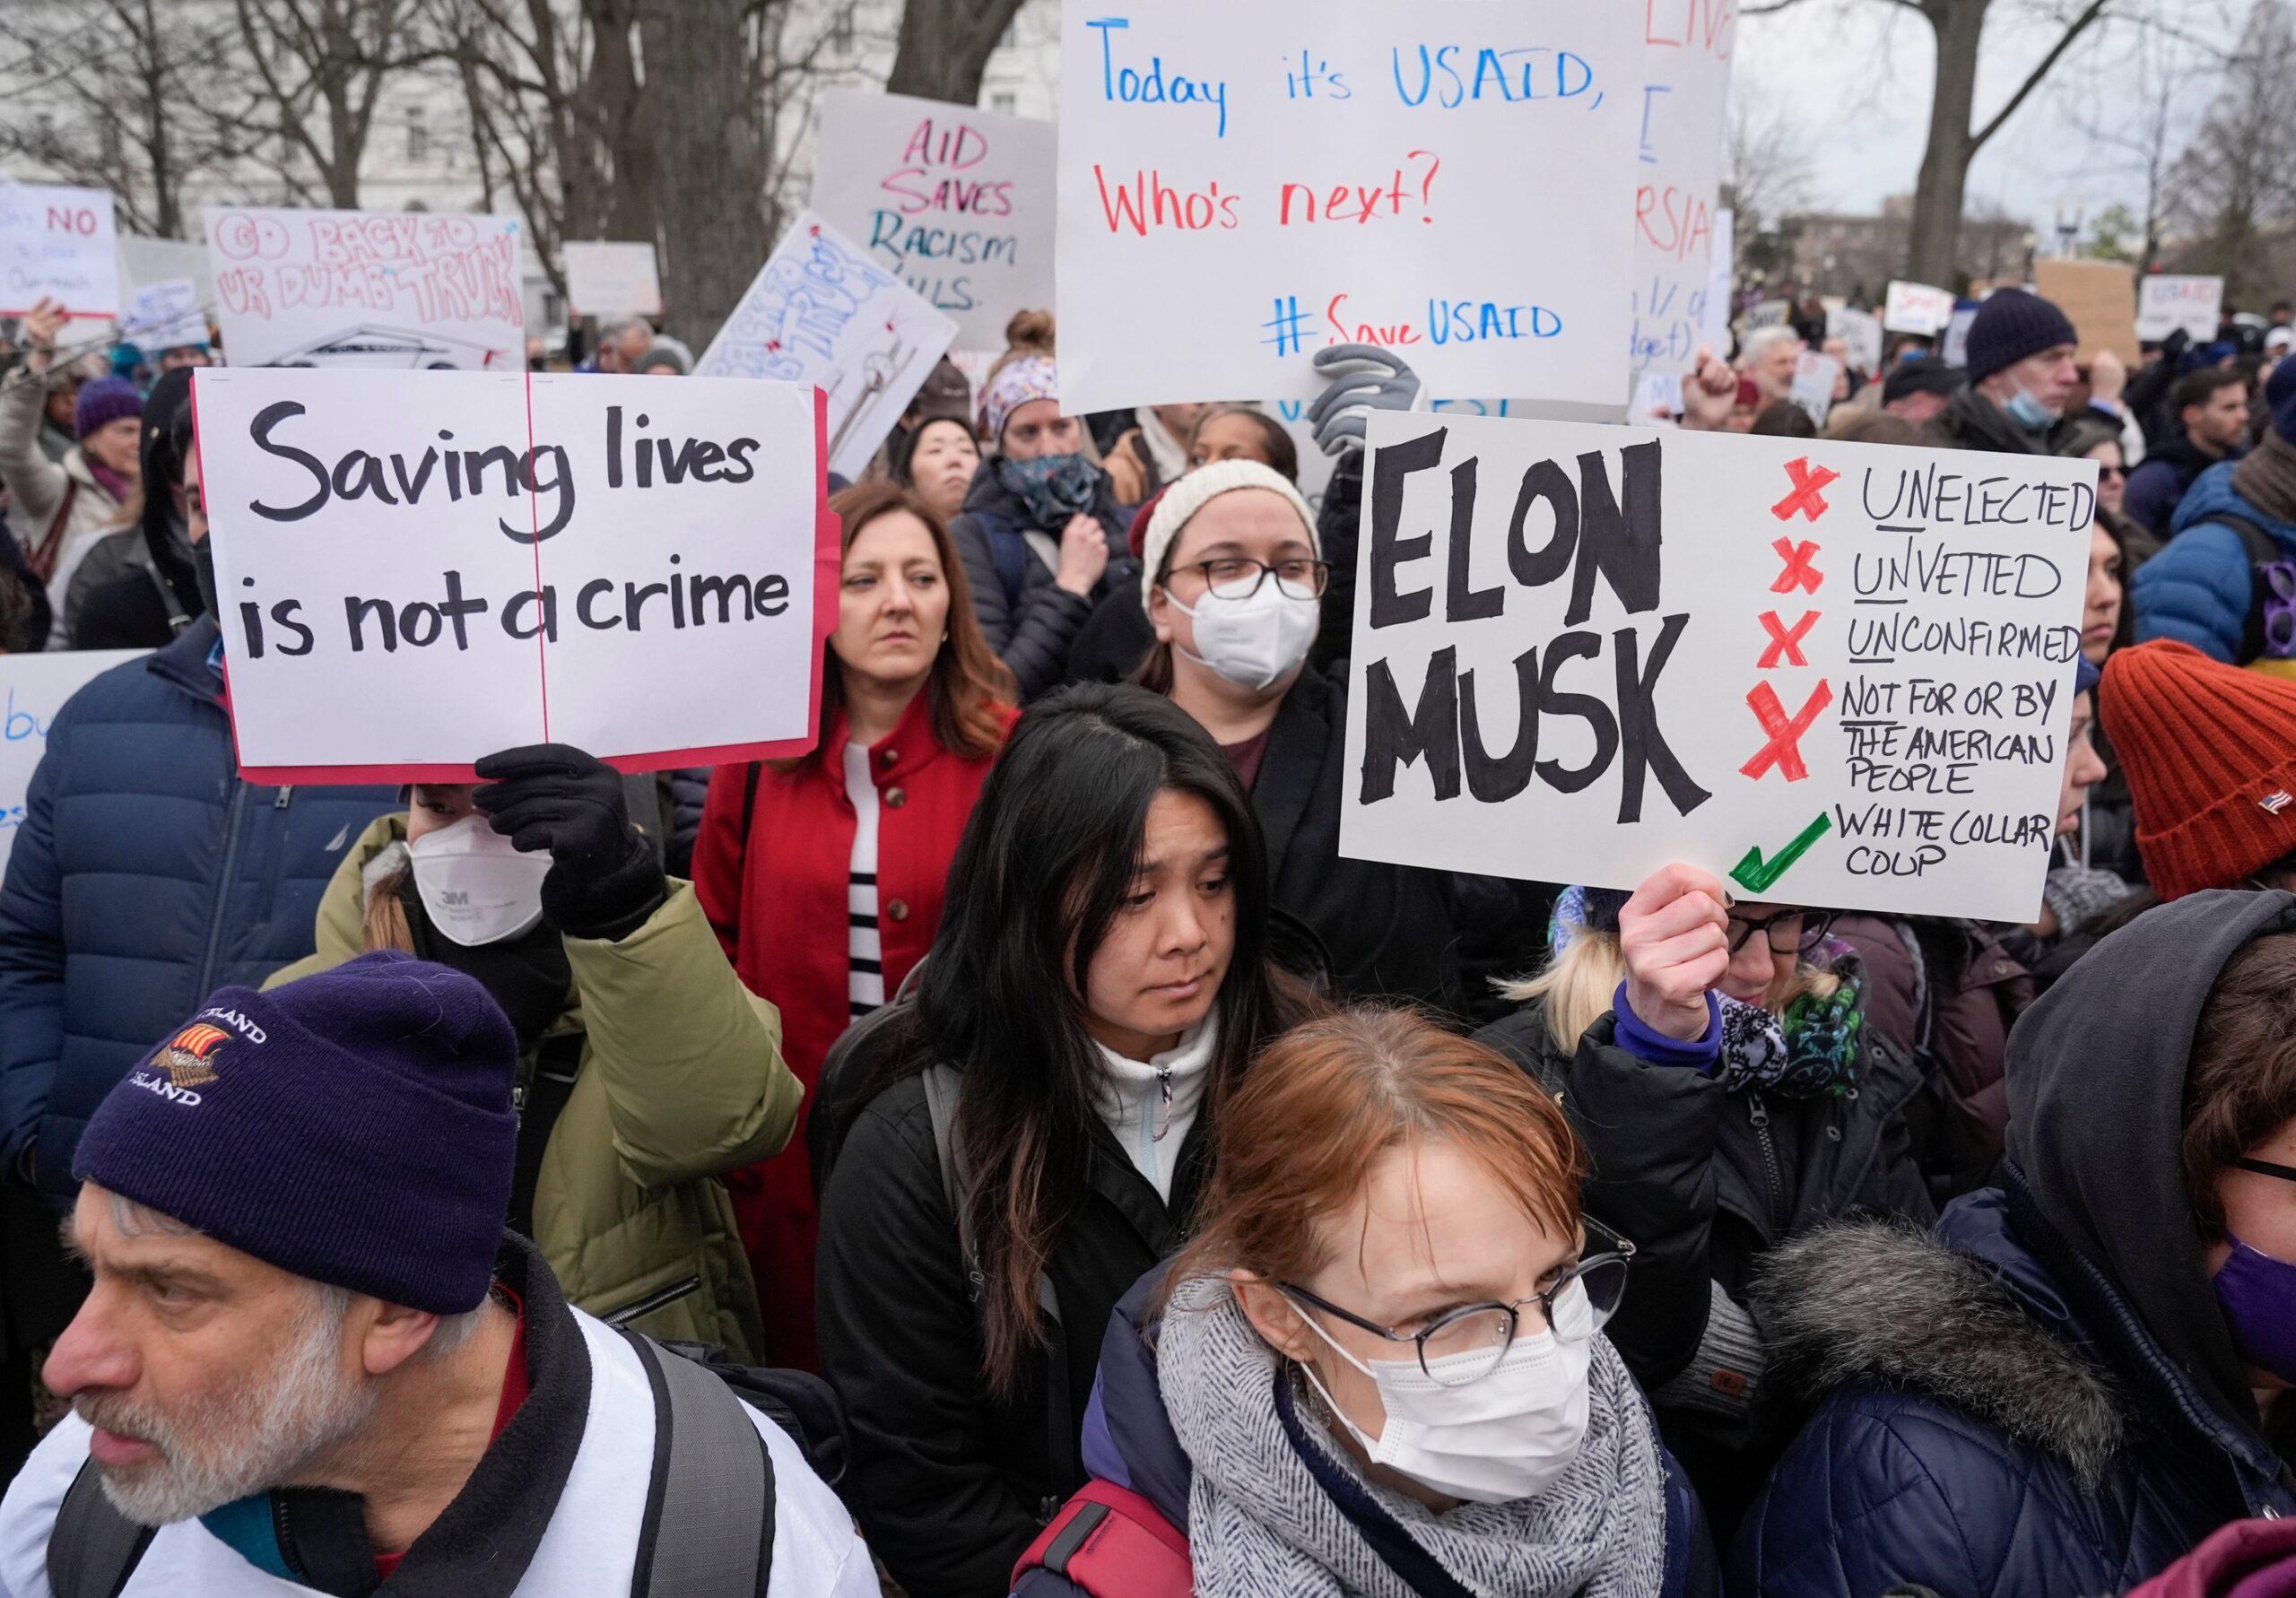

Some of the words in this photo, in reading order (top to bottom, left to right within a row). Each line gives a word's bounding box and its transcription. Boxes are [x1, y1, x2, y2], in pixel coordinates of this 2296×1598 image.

[1086, 18, 1227, 138] Today
[1283, 50, 1352, 100] it's
[1393, 44, 1604, 110] USAID,
[903, 117, 988, 169] AID
[47, 204, 98, 237] NO
[1093, 165, 1240, 236] Who's
[1280, 151, 1439, 226] next?
[214, 210, 291, 261] GO
[308, 214, 428, 267] BACK
[423, 214, 478, 248] TO
[216, 266, 272, 321] UR
[275, 262, 394, 312] DUMB
[393, 231, 525, 328] TRUCK
[249, 401, 576, 543] Saving
[606, 406, 761, 489] lives
[1863, 462, 2094, 532] UNELECTED
[1369, 426, 1664, 630] ELON
[1854, 535, 2061, 604] UNVETTED
[239, 576, 315, 660] is
[344, 569, 489, 653] not
[500, 583, 558, 646] a
[576, 553, 790, 632] crime
[1848, 612, 2082, 664] UNCONFIRMED
[1359, 612, 1712, 824] MUSK
[1841, 675, 1901, 717] NOT
[1909, 679, 1957, 716] FOR
[1964, 682, 2003, 718] OR
[2012, 679, 2057, 725] BY
[1843, 725, 1908, 759] THE
[1905, 726, 2054, 764] AMERICAN
[1846, 757, 1979, 794] PEOPLE
[1835, 803, 1945, 840] WHITE
[1950, 809, 2051, 852] COLLAR
[1846, 845, 1946, 876] COUP
[441, 890, 469, 906] 3M
